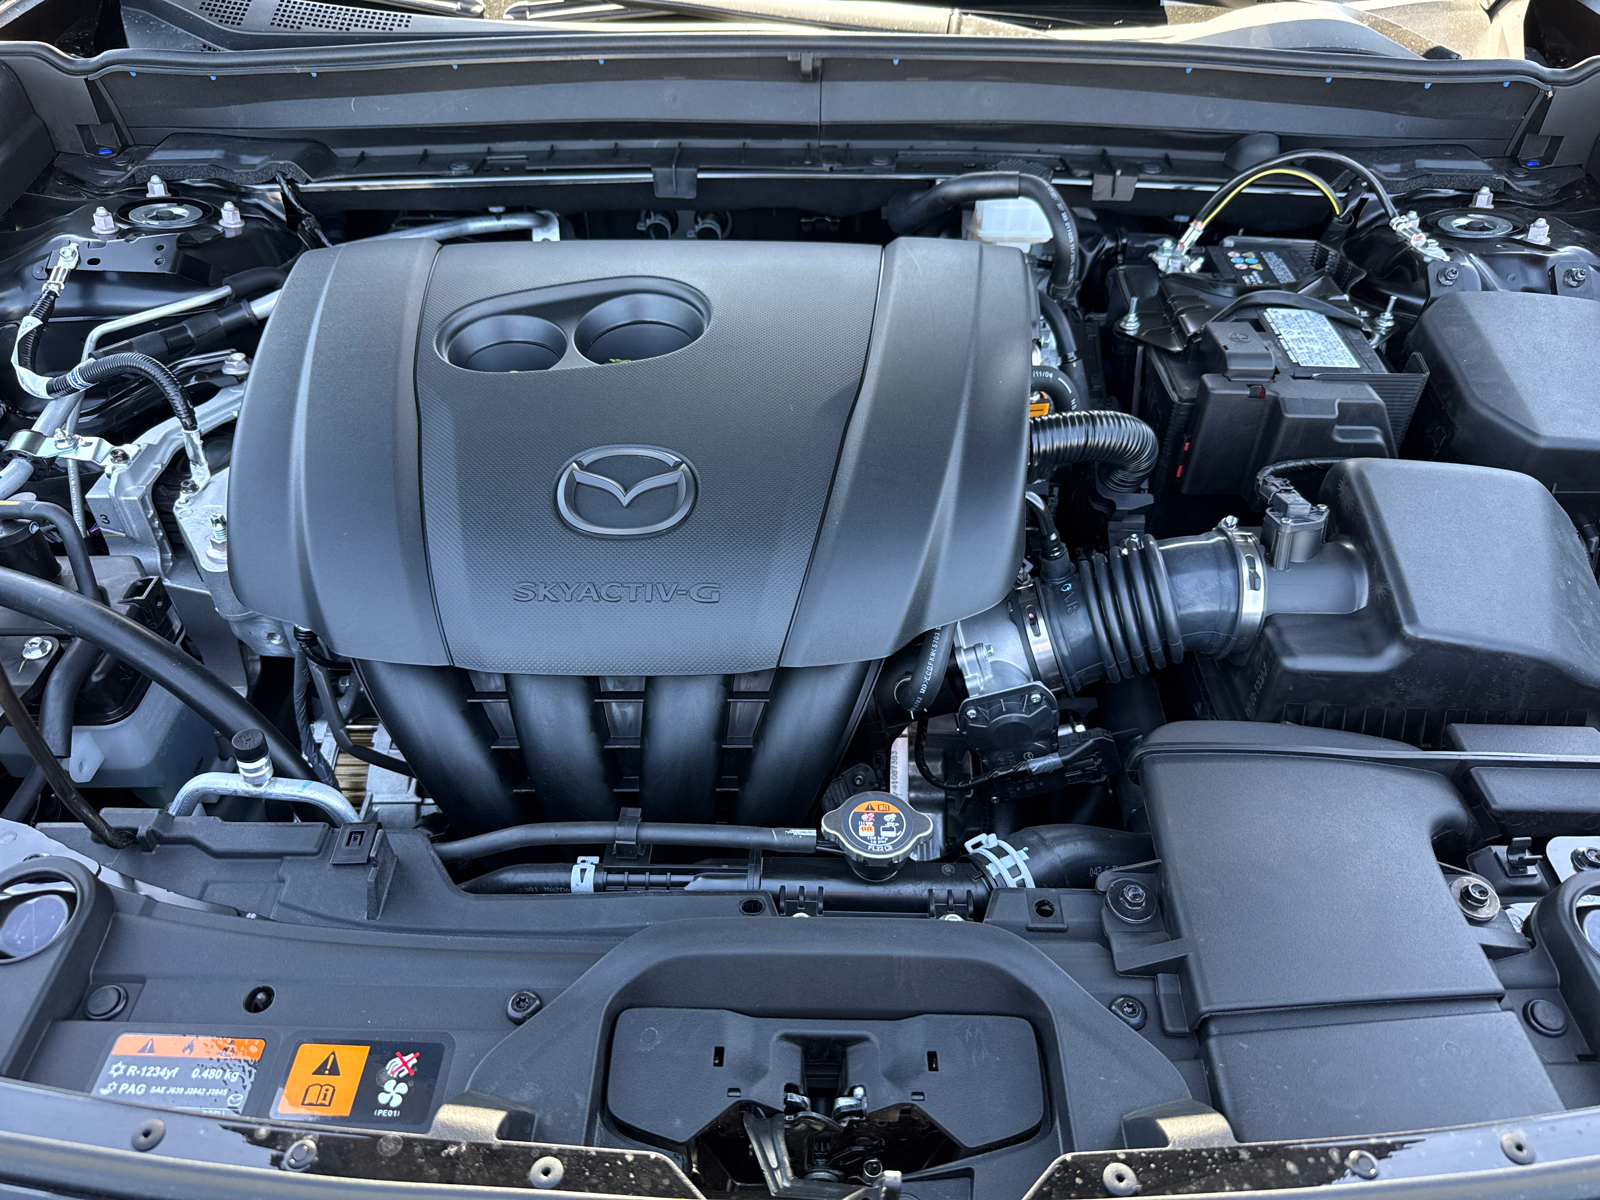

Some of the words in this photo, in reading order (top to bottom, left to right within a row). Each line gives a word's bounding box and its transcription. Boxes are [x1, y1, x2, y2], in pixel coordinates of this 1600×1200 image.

[100, 514, 111, 525] 3
[513, 581, 721, 604] SKYACTIV-G
[126, 1066, 180, 1080] R-1234yf
[191, 1068, 223, 1079] 0.480
[223, 1067, 240, 1082] kg
[118, 1083, 147, 1095] PAG
[149, 1085, 167, 1094] SAE
[166, 1085, 184, 1095] J639
[374, 1109, 400, 1117] (PE01)
